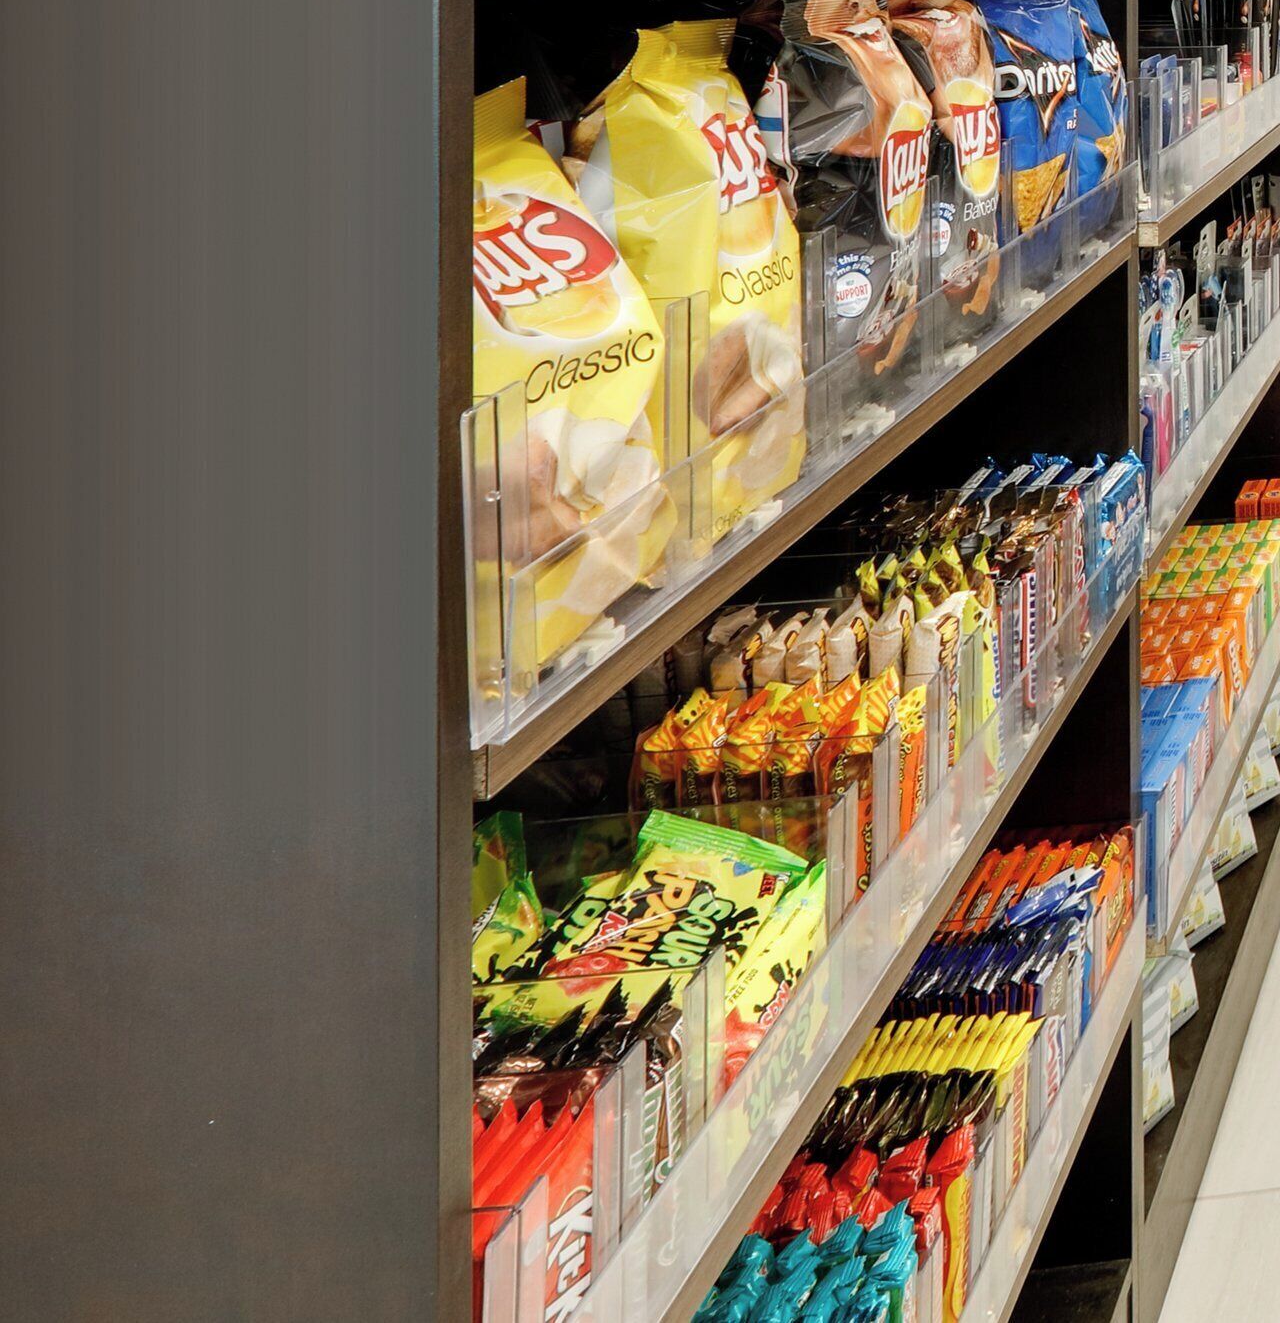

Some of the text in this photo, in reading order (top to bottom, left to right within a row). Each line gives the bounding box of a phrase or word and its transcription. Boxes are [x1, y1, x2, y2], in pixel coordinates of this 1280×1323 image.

[473, 210, 588, 307] ay's
[720, 250, 795, 306] Classic
[835, 283, 870, 302] SUPPORT
[526, 328, 657, 404] Classic
[650, 892, 735, 969] SOUR
